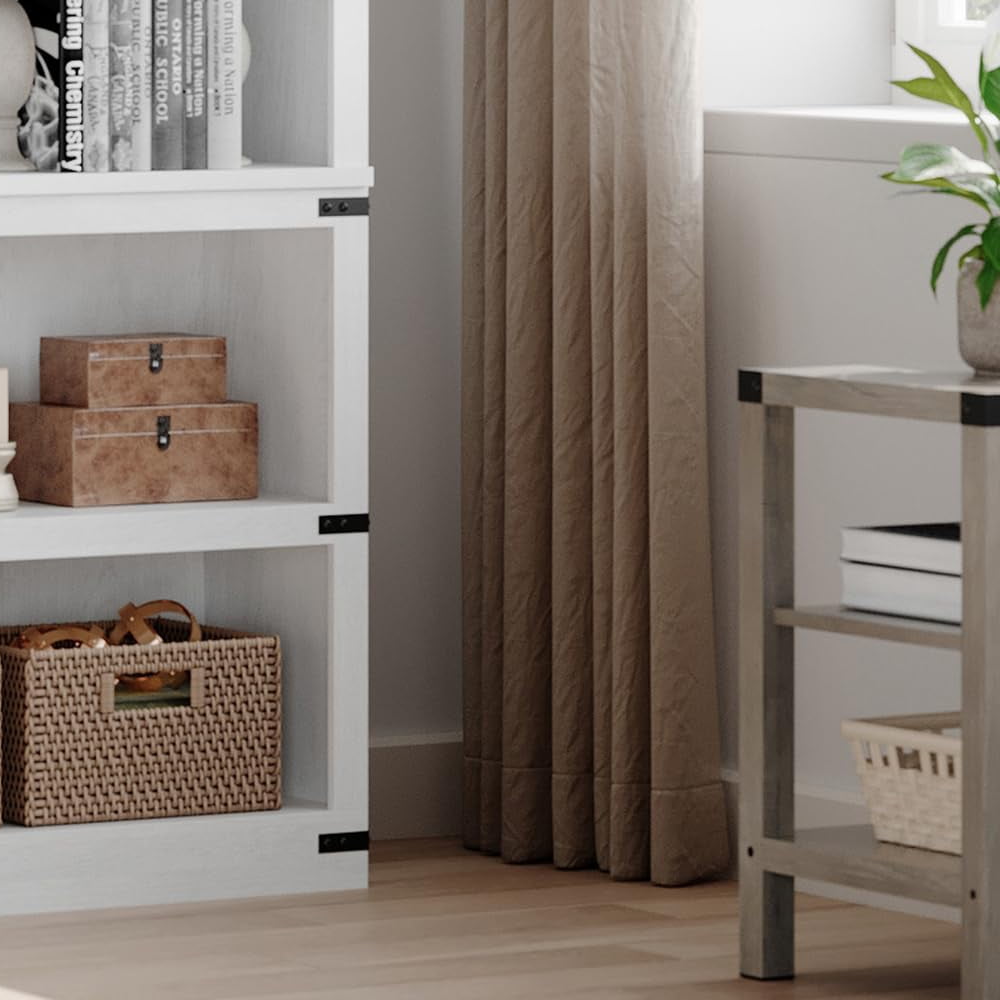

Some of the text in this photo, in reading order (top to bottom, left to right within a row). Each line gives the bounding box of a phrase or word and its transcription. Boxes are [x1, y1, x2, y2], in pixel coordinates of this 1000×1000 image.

[155, 57, 169, 125] SCHOOL
[171, 18, 182, 96] ONTARIO
[63, 60, 84, 172] Chemistry
[131, 63, 141, 126] SCHOOL
[224, 69, 237, 116] Nation
